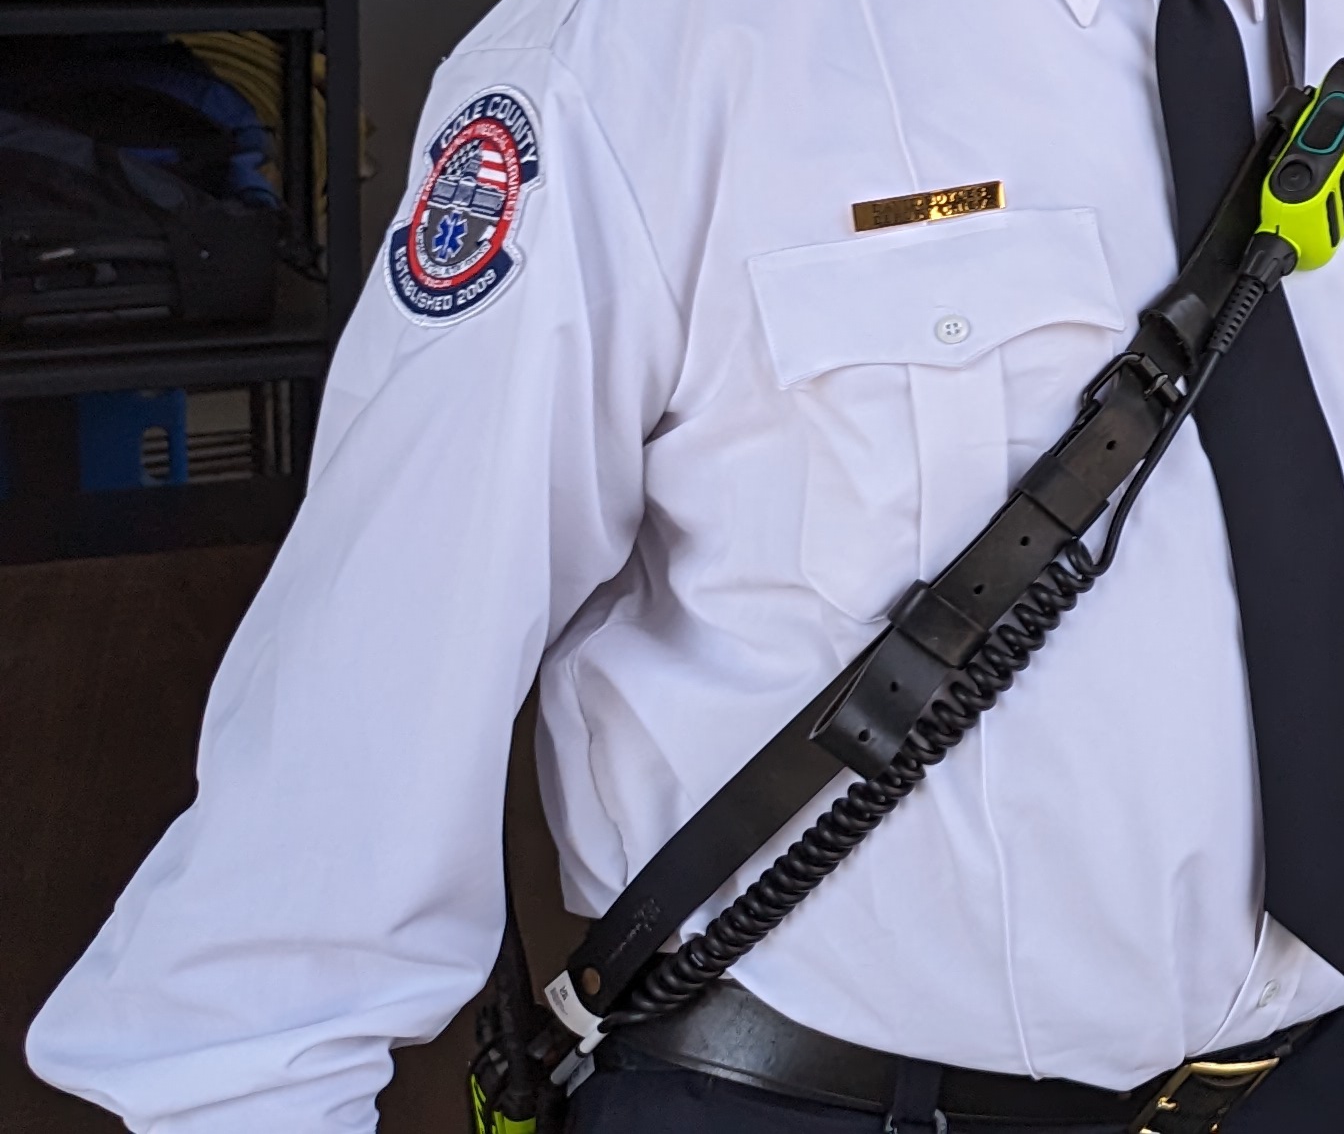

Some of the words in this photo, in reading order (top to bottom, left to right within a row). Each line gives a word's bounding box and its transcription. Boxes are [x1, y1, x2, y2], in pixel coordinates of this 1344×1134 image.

[440, 99, 485, 149] COLE
[486, 96, 537, 163] COUNTY
[395, 246, 452, 311] ESTABLISHED
